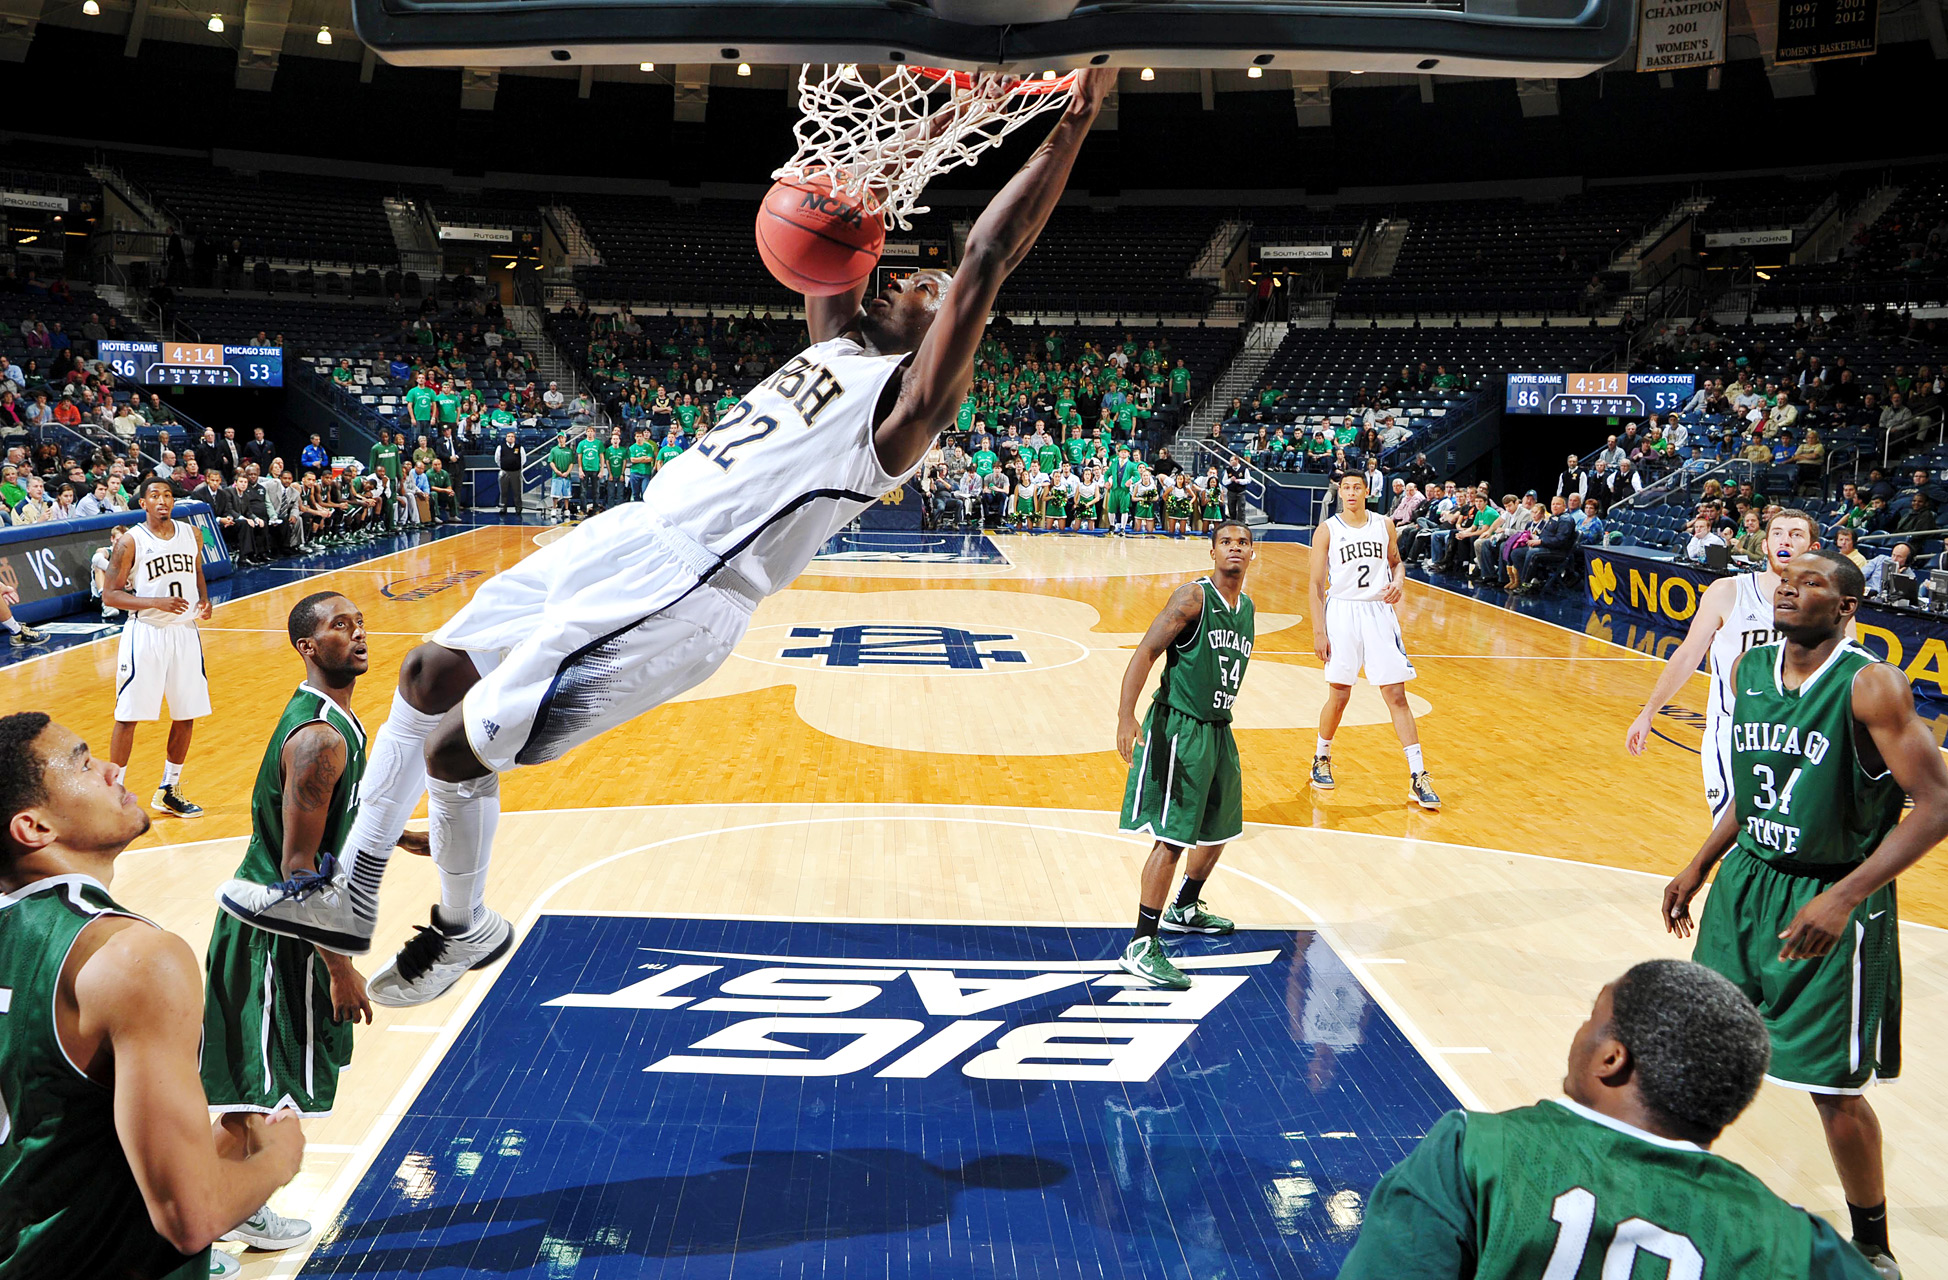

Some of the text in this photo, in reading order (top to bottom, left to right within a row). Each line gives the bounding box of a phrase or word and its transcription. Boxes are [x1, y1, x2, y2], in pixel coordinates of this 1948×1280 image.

[1645, 1, 1722, 20] CHAMPION
[1789, 2, 1818, 16] 1997
[1835, 10, 1865, 24] 2012
[1668, 21, 1698, 35] 2001
[1789, 16, 1816, 30] 2011
[1655, 39, 1709, 54] WOMEN'S
[1780, 38, 1873, 57] WOMEN'S BASKETBALL
[1646, 50, 1715, 66] BASKETBALL
[4, 197, 63, 209] PROVIDENCE
[800, 191, 862, 229] NCAA
[473, 232, 510, 241] RUTGERS
[101, 342, 158, 353] NOTRE DAME
[172, 347, 215, 363] 4:14
[224, 346, 281, 356] CHICAGO STATE
[111, 359, 135, 377] 86
[249, 363, 270, 380] 53
[174, 374, 181, 384] 3
[191, 374, 198, 384] 2
[207, 375, 215, 384] 4
[1511, 375, 1562, 384] NOTRE DAME
[1575, 377, 1618, 393] 4:14
[1629, 375, 1693, 384] CHICAGO STATE
[1518, 391, 1539, 407] 86
[1655, 392, 1677, 409] 53
[1575, 404, 1582, 414] 3
[1592, 404, 1600, 414] 2
[1609, 405, 1617, 414] 4
[697, 400, 781, 473] 22
[1339, 541, 1383, 565] IRISH
[25, 547, 72, 590] VS.
[145, 553, 194, 581] IRISH
[1357, 565, 1370, 589] 2
[168, 581, 183, 599] 0
[1629, 568, 1710, 621] NO
[1207, 629, 1252, 659] CHICAGO
[1741, 629, 1786, 653] IRI
[1218, 655, 1241, 690] 54
[1733, 721, 1830, 766] CHICAGO
[1752, 763, 1802, 816] 34
[540, 963, 1250, 1021] EAST
[642, 1017, 1199, 1082] BIG
